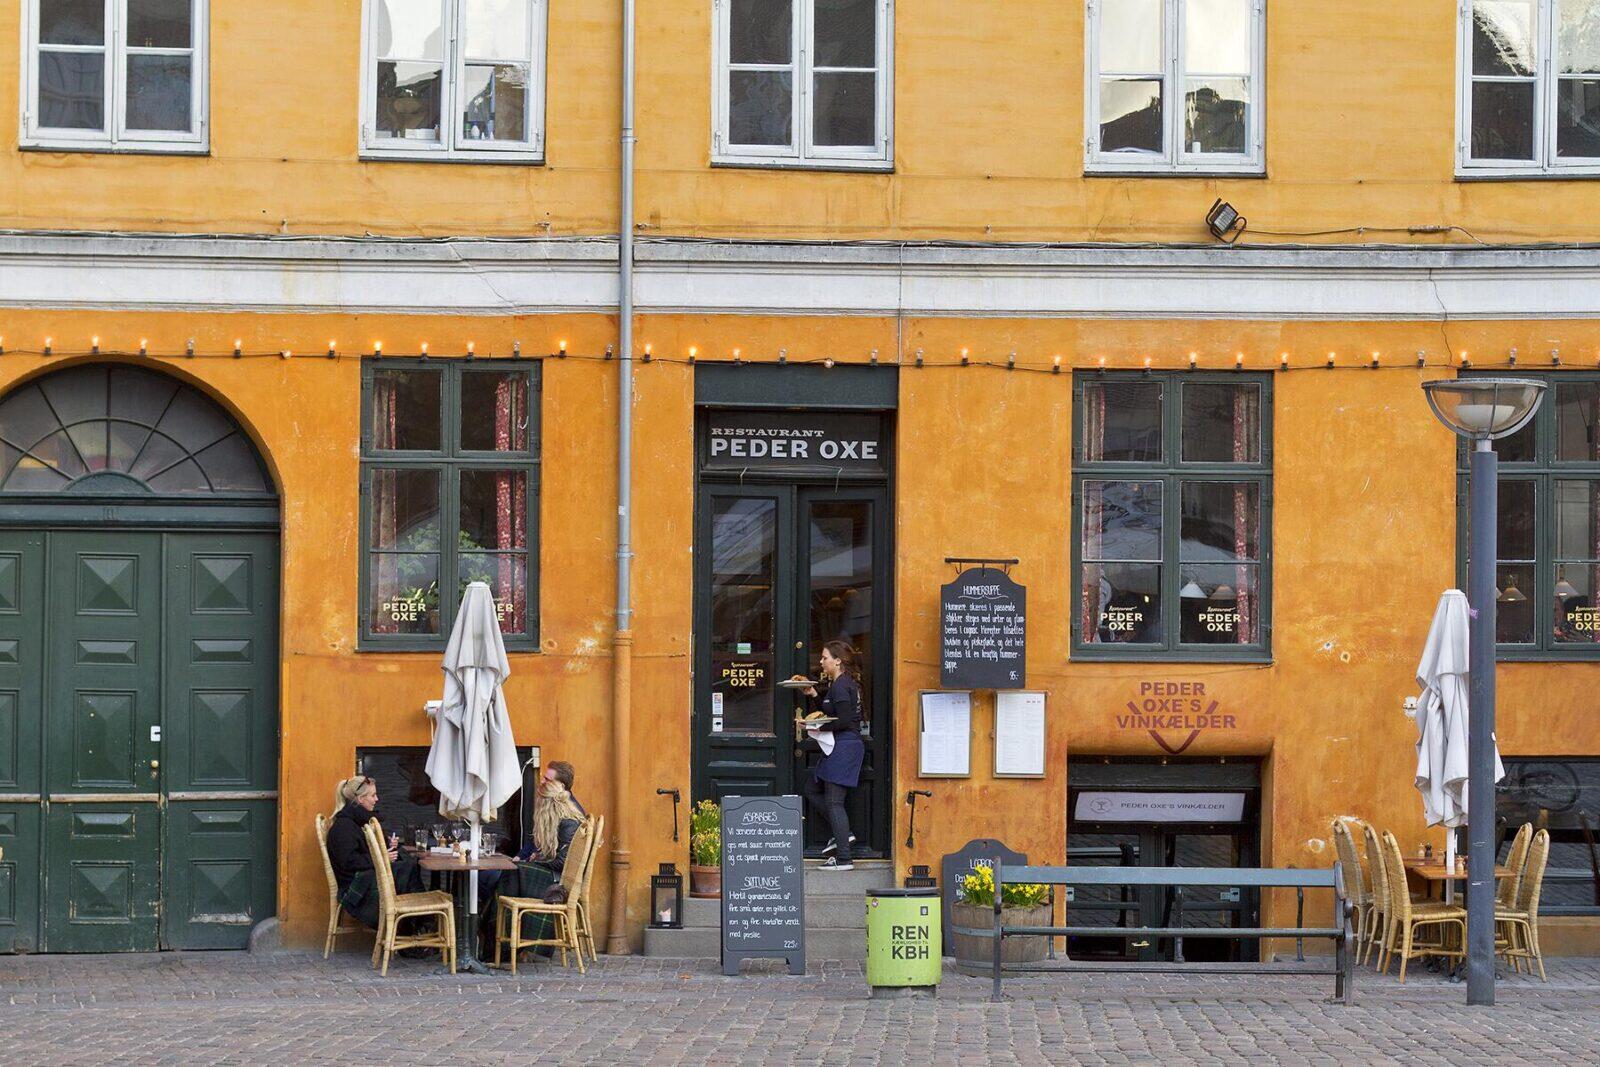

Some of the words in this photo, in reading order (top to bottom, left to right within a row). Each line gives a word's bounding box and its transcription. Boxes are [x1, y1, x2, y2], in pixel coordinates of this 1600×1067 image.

[711, 428, 824, 437] RESTAURANT
[711, 438, 808, 458] PEDER
[819, 440, 878, 459] OXE
[963, 585, 1001, 596] HUMMERSUPPE
[382, 603, 426, 612] PEDER
[391, 612, 417, 622] OXE
[1100, 612, 1143, 622] PEDER
[1198, 613, 1241, 622] PEDER
[1567, 613, 1600, 621] PEDE
[1108, 621, 1134, 631] OXE
[1206, 623, 1233, 632] OXE
[1575, 622, 1600, 630] OXE
[722, 669, 764, 678] PEDER
[730, 678, 756, 687] OXE
[1141, 682, 1205, 696] PEDER
[1116, 715, 1236, 728] VINKÆLDER
[742, 811, 778, 822] ASPARGES
[727, 855, 735, 866] og
[742, 919, 749, 930] og
[892, 925, 929, 940] REN
[892, 945, 929, 959] KBH
